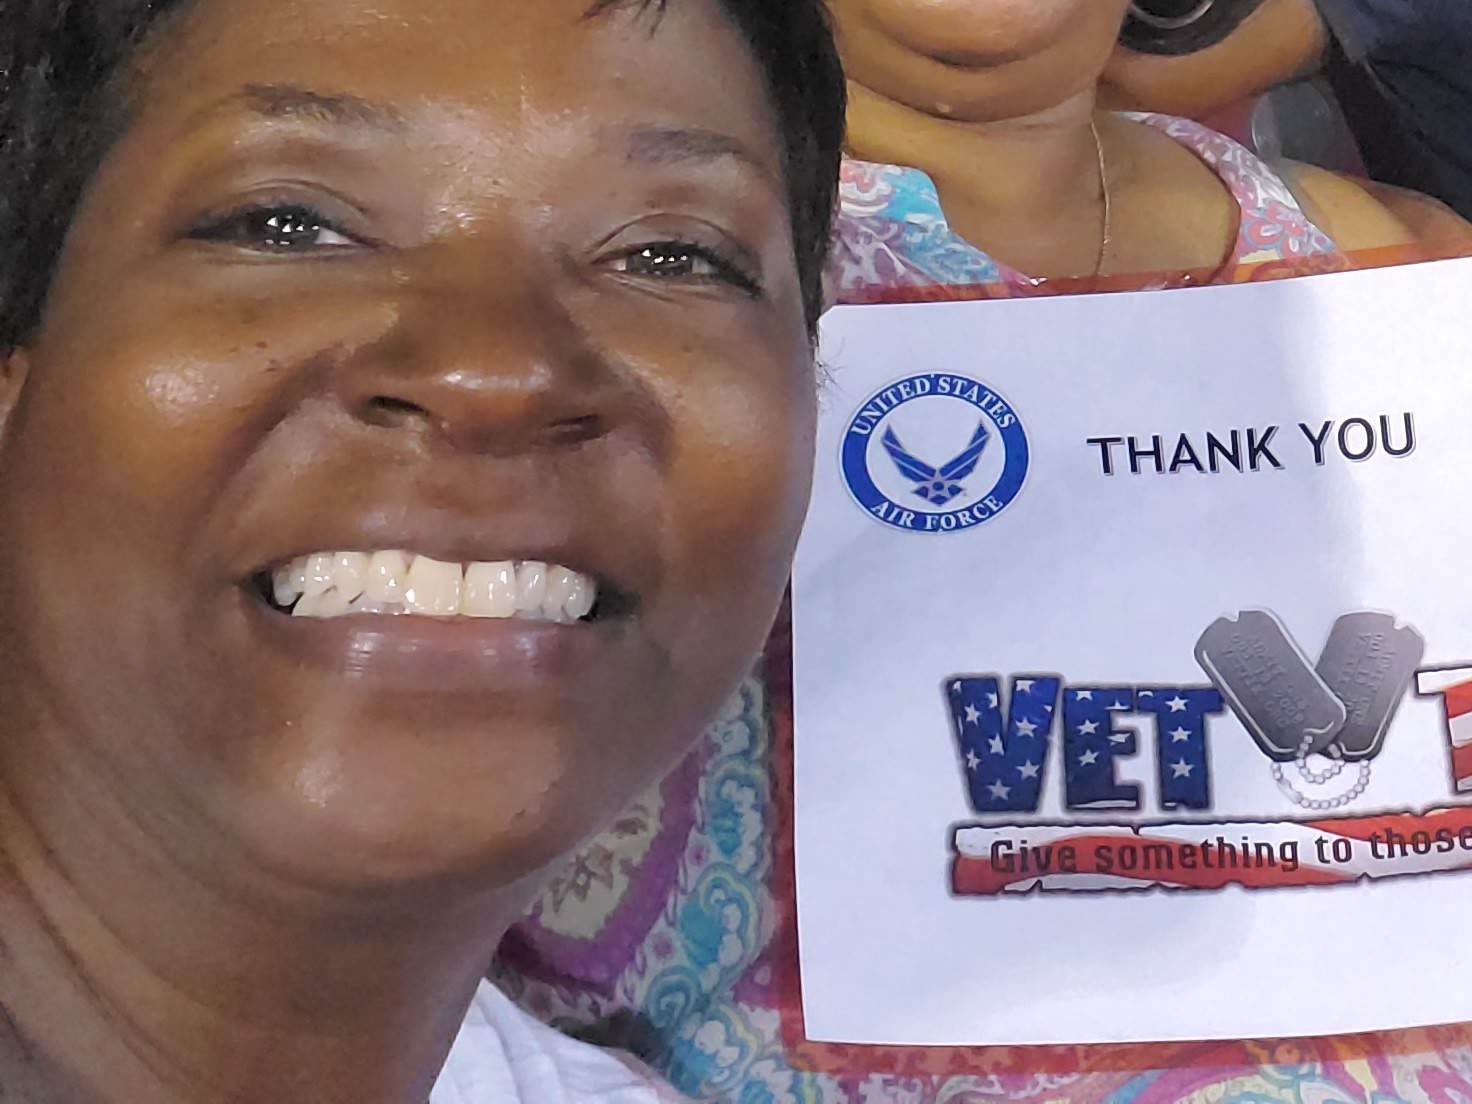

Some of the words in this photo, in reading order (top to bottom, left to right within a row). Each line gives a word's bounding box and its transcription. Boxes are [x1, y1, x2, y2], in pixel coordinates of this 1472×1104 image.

[850, 378, 931, 435] UNITED
[937, 377, 1016, 429] STATES
[1086, 425, 1285, 476] THANK
[1297, 412, 1416, 466] YOU
[871, 500, 915, 528] AIR
[925, 495, 1004, 530] FORCE
[946, 676, 1226, 812] VET
[989, 839, 1077, 873] Give
[1095, 836, 1300, 873] something
[1315, 836, 1353, 864] to
